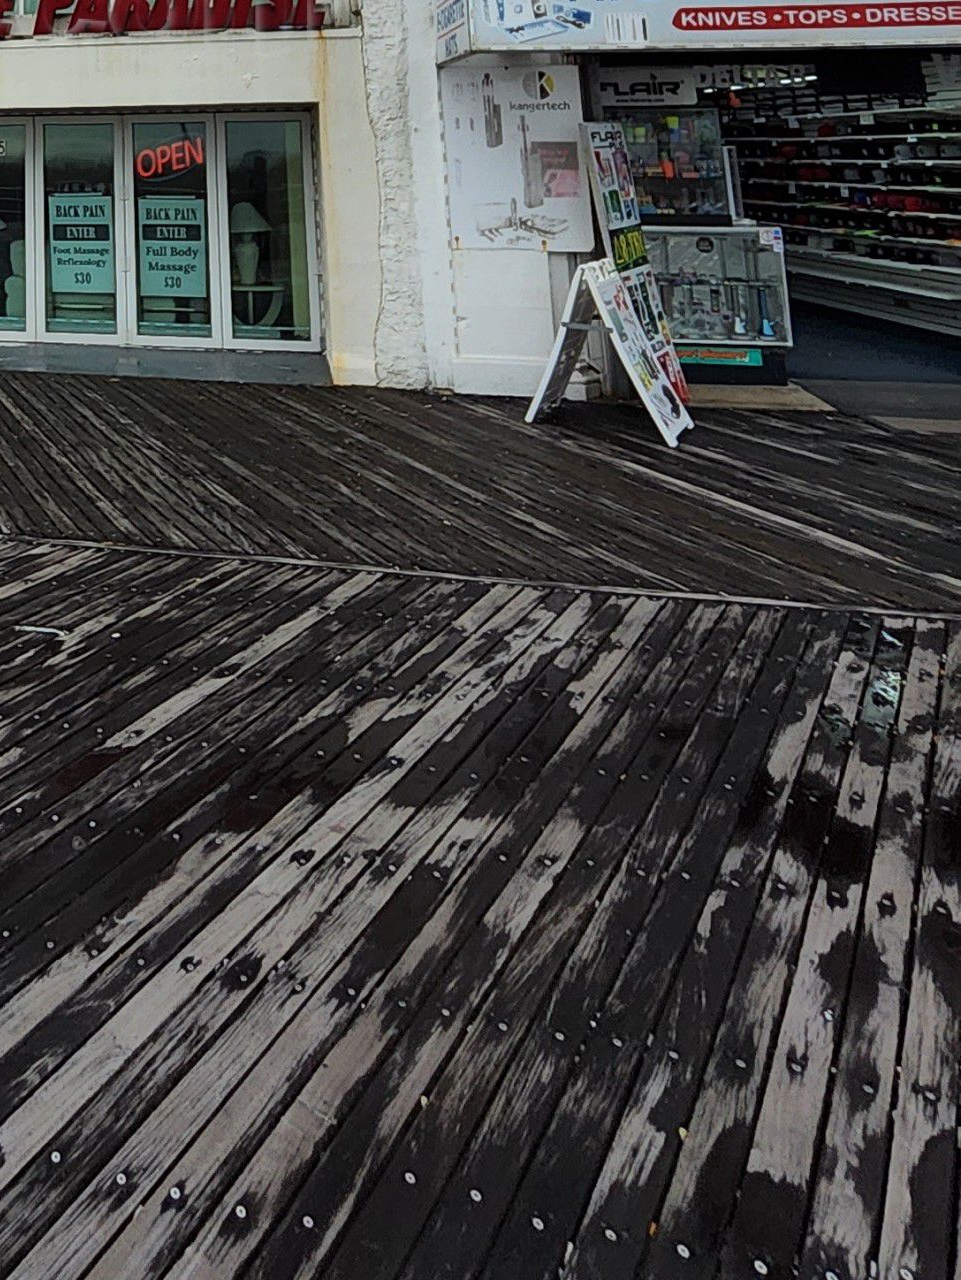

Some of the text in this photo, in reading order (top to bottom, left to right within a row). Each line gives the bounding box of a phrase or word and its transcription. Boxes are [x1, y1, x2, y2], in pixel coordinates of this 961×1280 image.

[681, 11, 768, 27] KNIVES
[783, 9, 848, 24] TOPS
[509, 101, 570, 112] kangertech
[136, 137, 203, 177] OPEN
[55, 205, 105, 217] BACK PAIN
[145, 208, 197, 220] BACK PAIN
[66, 227, 96, 238] ENTER
[157, 227, 187, 238] ENTER
[53, 246, 110, 256] Foot Massage
[145, 246, 199, 259] Full Body
[148, 262, 197, 274] Massage
